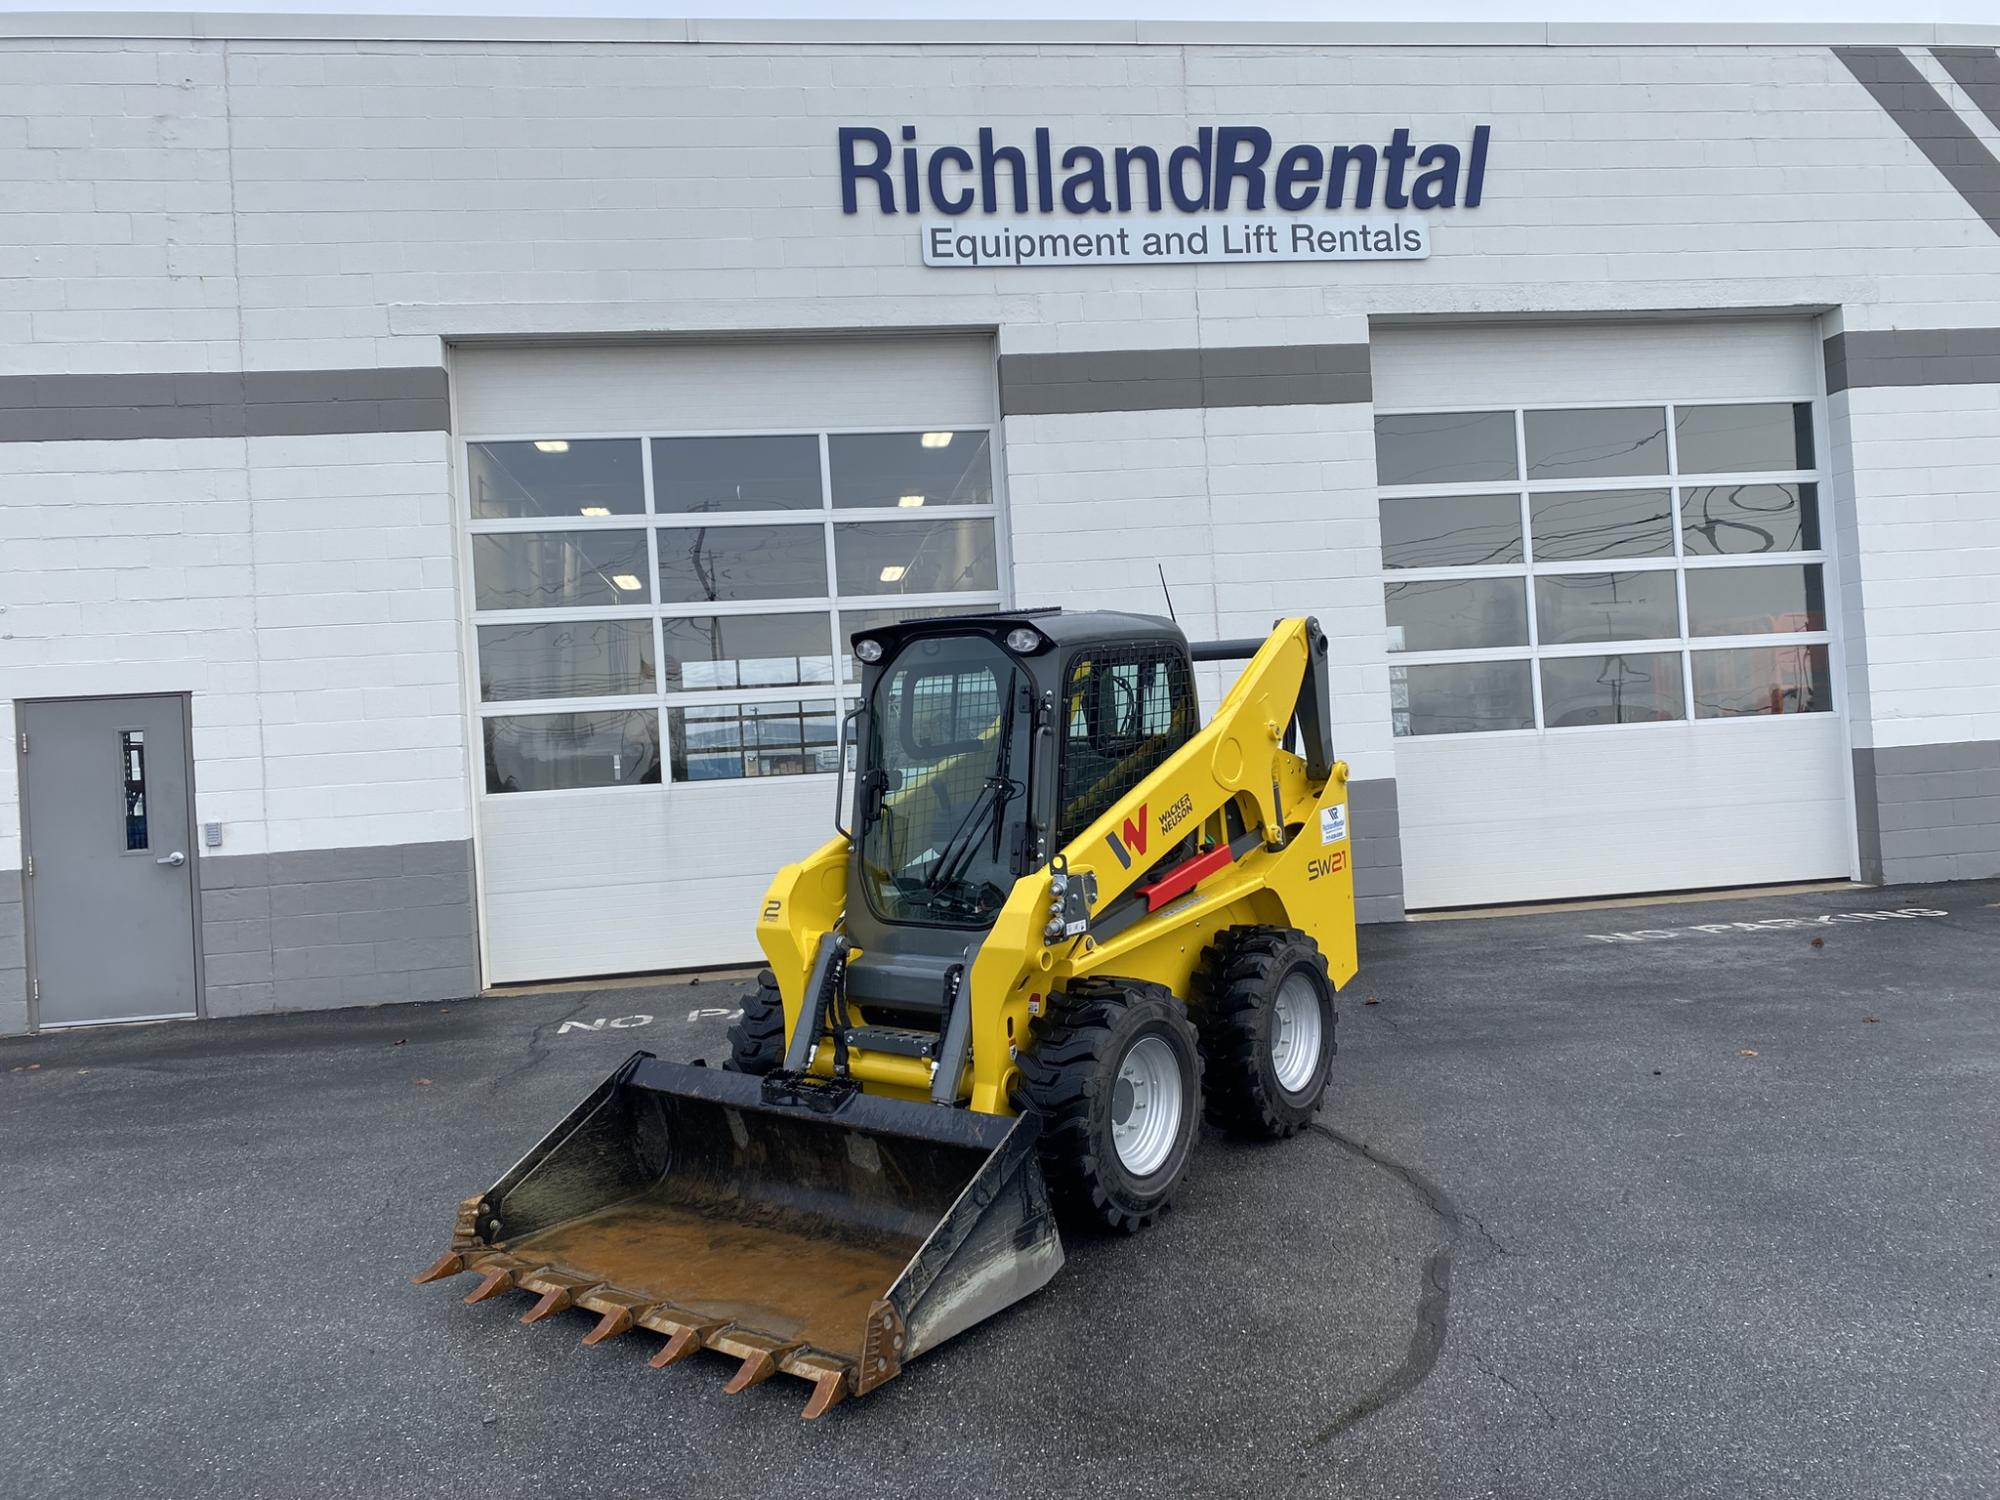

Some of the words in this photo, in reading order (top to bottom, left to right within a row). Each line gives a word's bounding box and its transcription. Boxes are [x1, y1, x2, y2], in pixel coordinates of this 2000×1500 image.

[838, 125, 1491, 215] RichlandRental
[930, 227, 1129, 265] Equipment
[1142, 224, 1208, 256] and
[1222, 223, 1278, 254] Lift
[1291, 222, 1422, 252] Rentals
[1158, 793, 1190, 825] WACKER
[1162, 802, 1193, 836] NEUSON
[1307, 850, 1346, 881] SW21
[1584, 929, 1679, 943] NO
[1688, 908, 1949, 933] PARKING
[556, 1014, 654, 1034] NO
